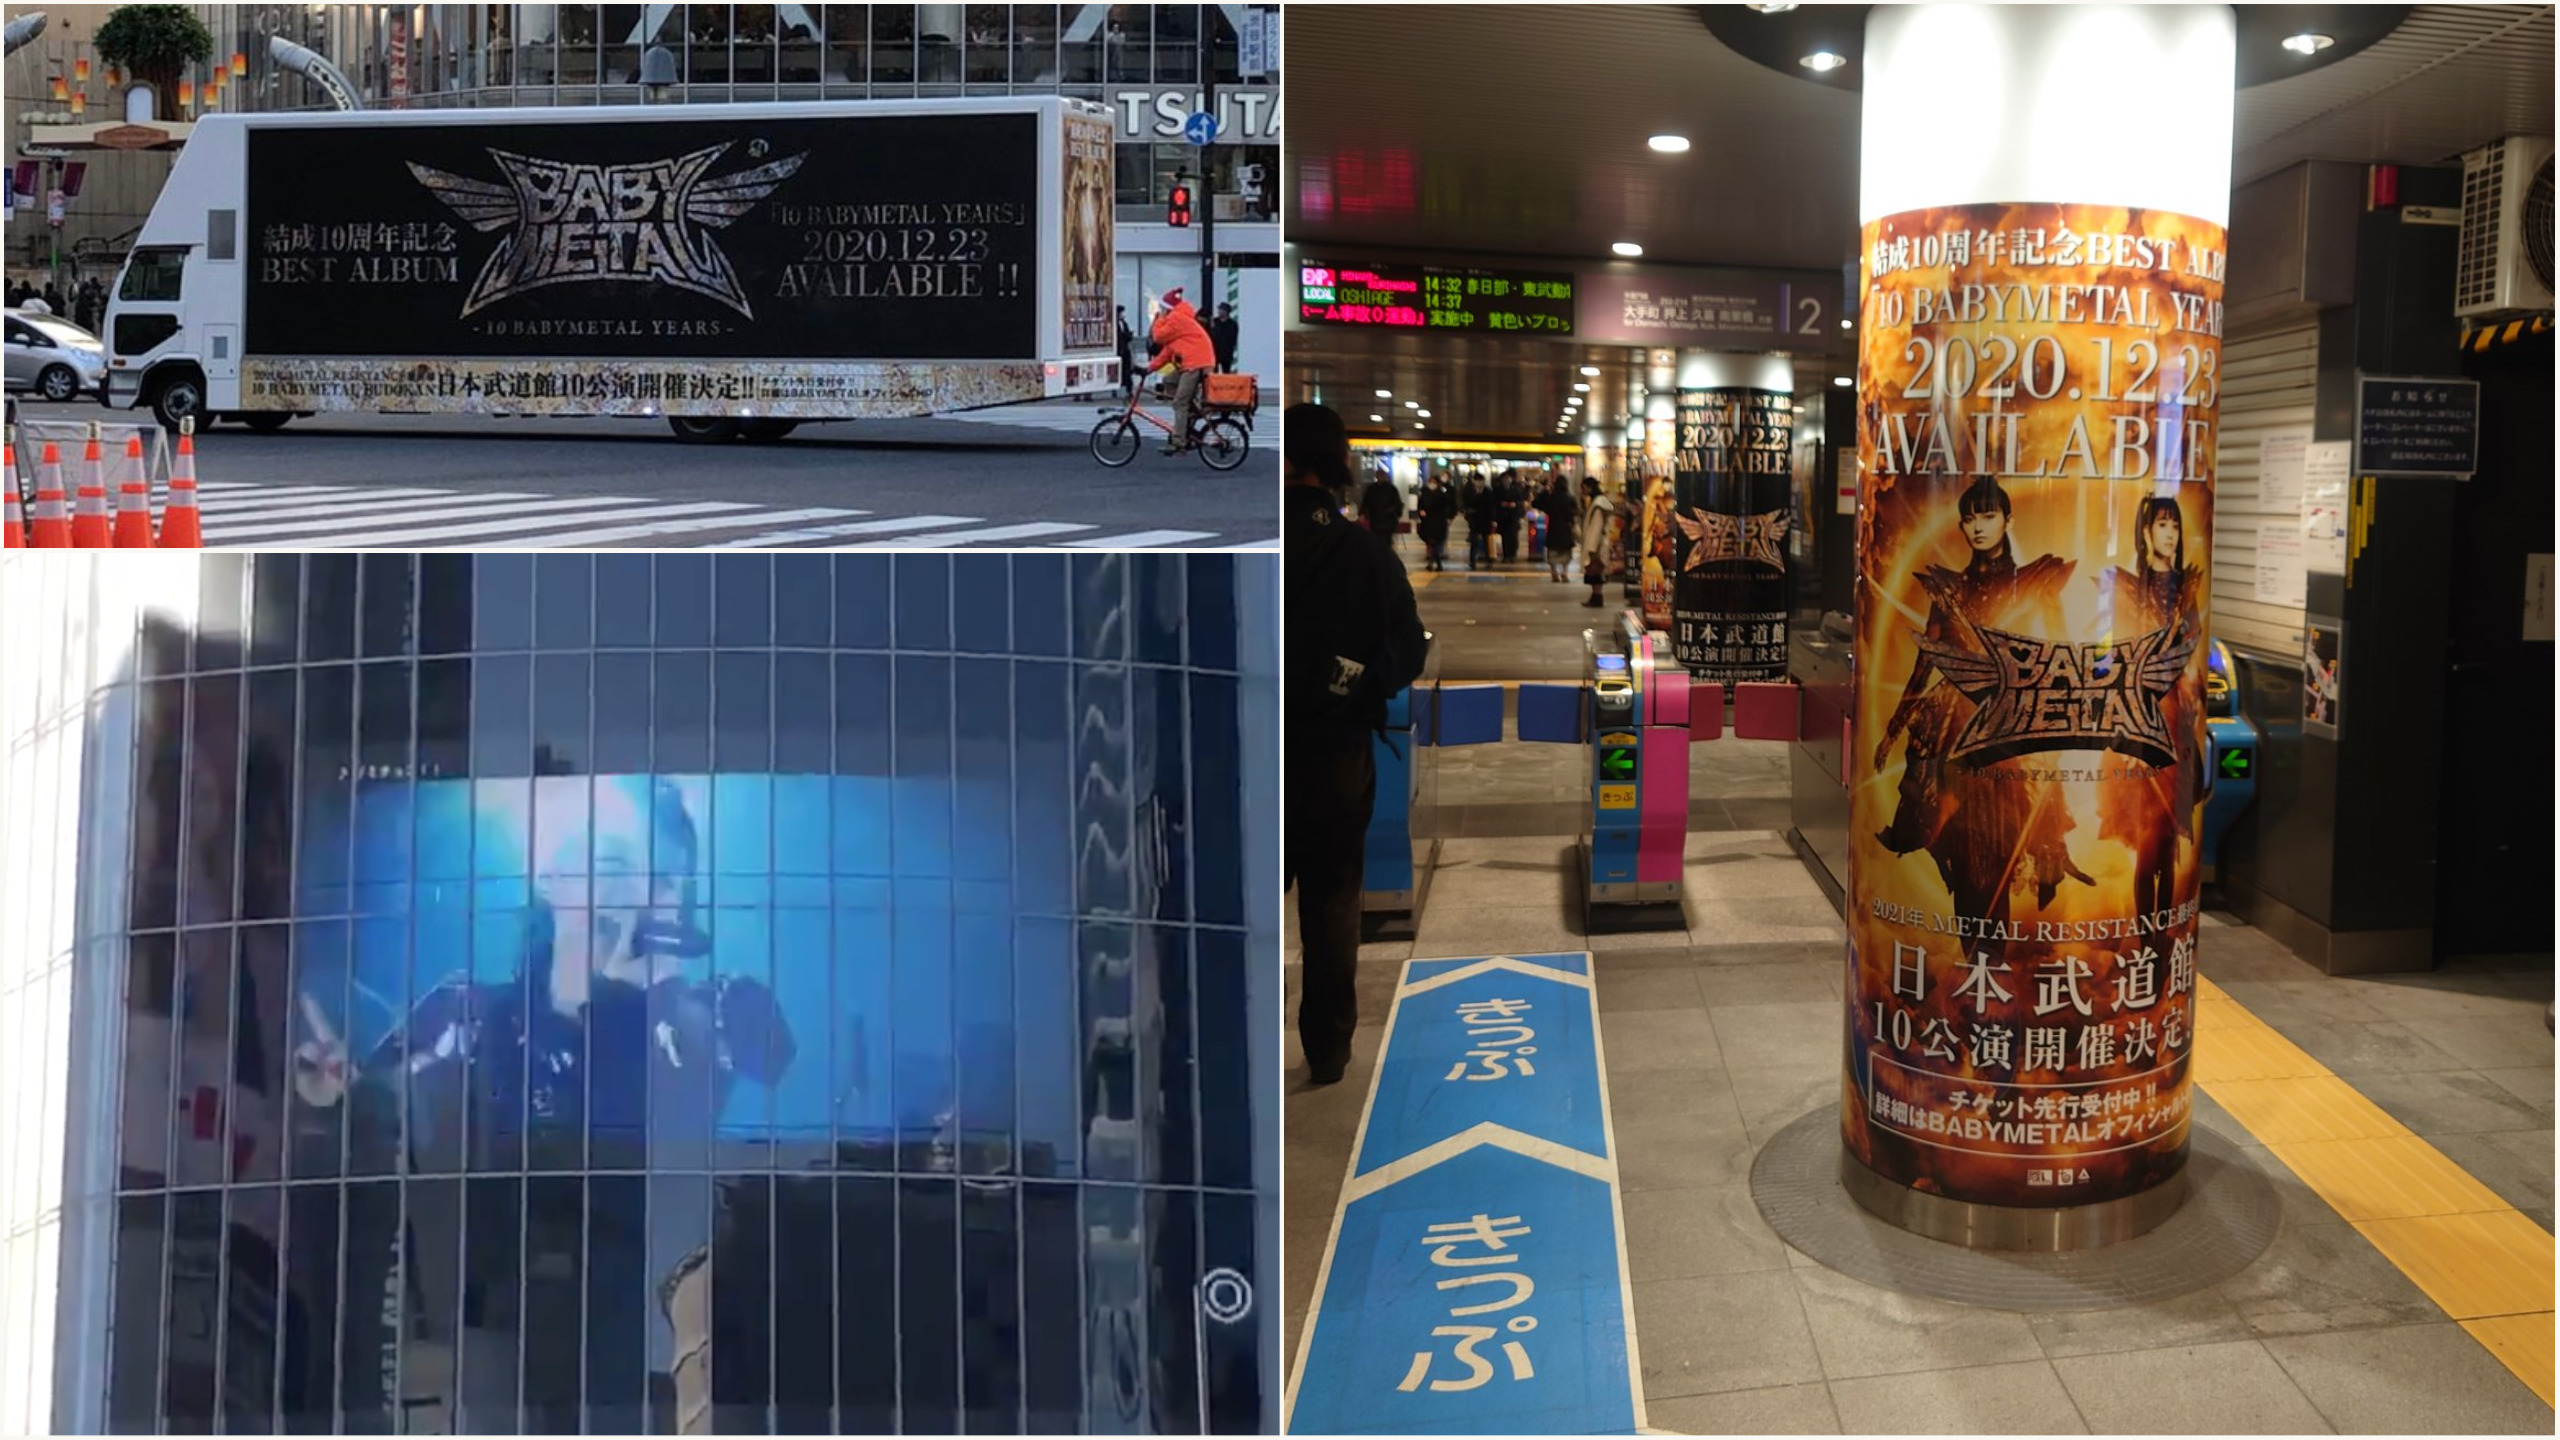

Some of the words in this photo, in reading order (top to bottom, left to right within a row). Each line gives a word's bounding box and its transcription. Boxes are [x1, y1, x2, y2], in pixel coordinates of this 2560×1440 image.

[503, 160, 712, 222] BABY
[808, 203, 936, 225] BABYMETAL
[264, 222, 456, 252] 結成10周年記念
[803, 228, 989, 262] 2020.12.23
[261, 256, 337, 283] BEST
[350, 256, 459, 283] ALBUM
[776, 263, 984, 297] AVAILABLE
[1425, 276, 1462, 293] 14:32
[1303, 287, 1335, 301] LOCAL
[1341, 288, 1395, 306] OSHIAGE
[1425, 293, 1462, 309] 14:37
[1911, 282, 2161, 329] BABYMETAL
[487, 319, 507, 335] 10
[512, 319, 643, 335] BABYMETAL
[652, 319, 722, 335] YEARS
[1798, 297, 1821, 335] 2
[1902, 336, 2218, 408] 2020.12.23
[269, 383, 359, 396] BABYMETAL
[1683, 425, 1789, 451] 2020.12.23
[1872, 412, 2210, 483] AVAILABLE
[1680, 622, 1786, 645] 日本武道館
[1998, 632, 2160, 690] BABY
[1992, 767, 2106, 782] BABYMETAL
[1891, 931, 2195, 1017] 日本武道館
[1444, 998, 1538, 1081] きっぷ
[1396, 1213, 1539, 1392] きっぷ
